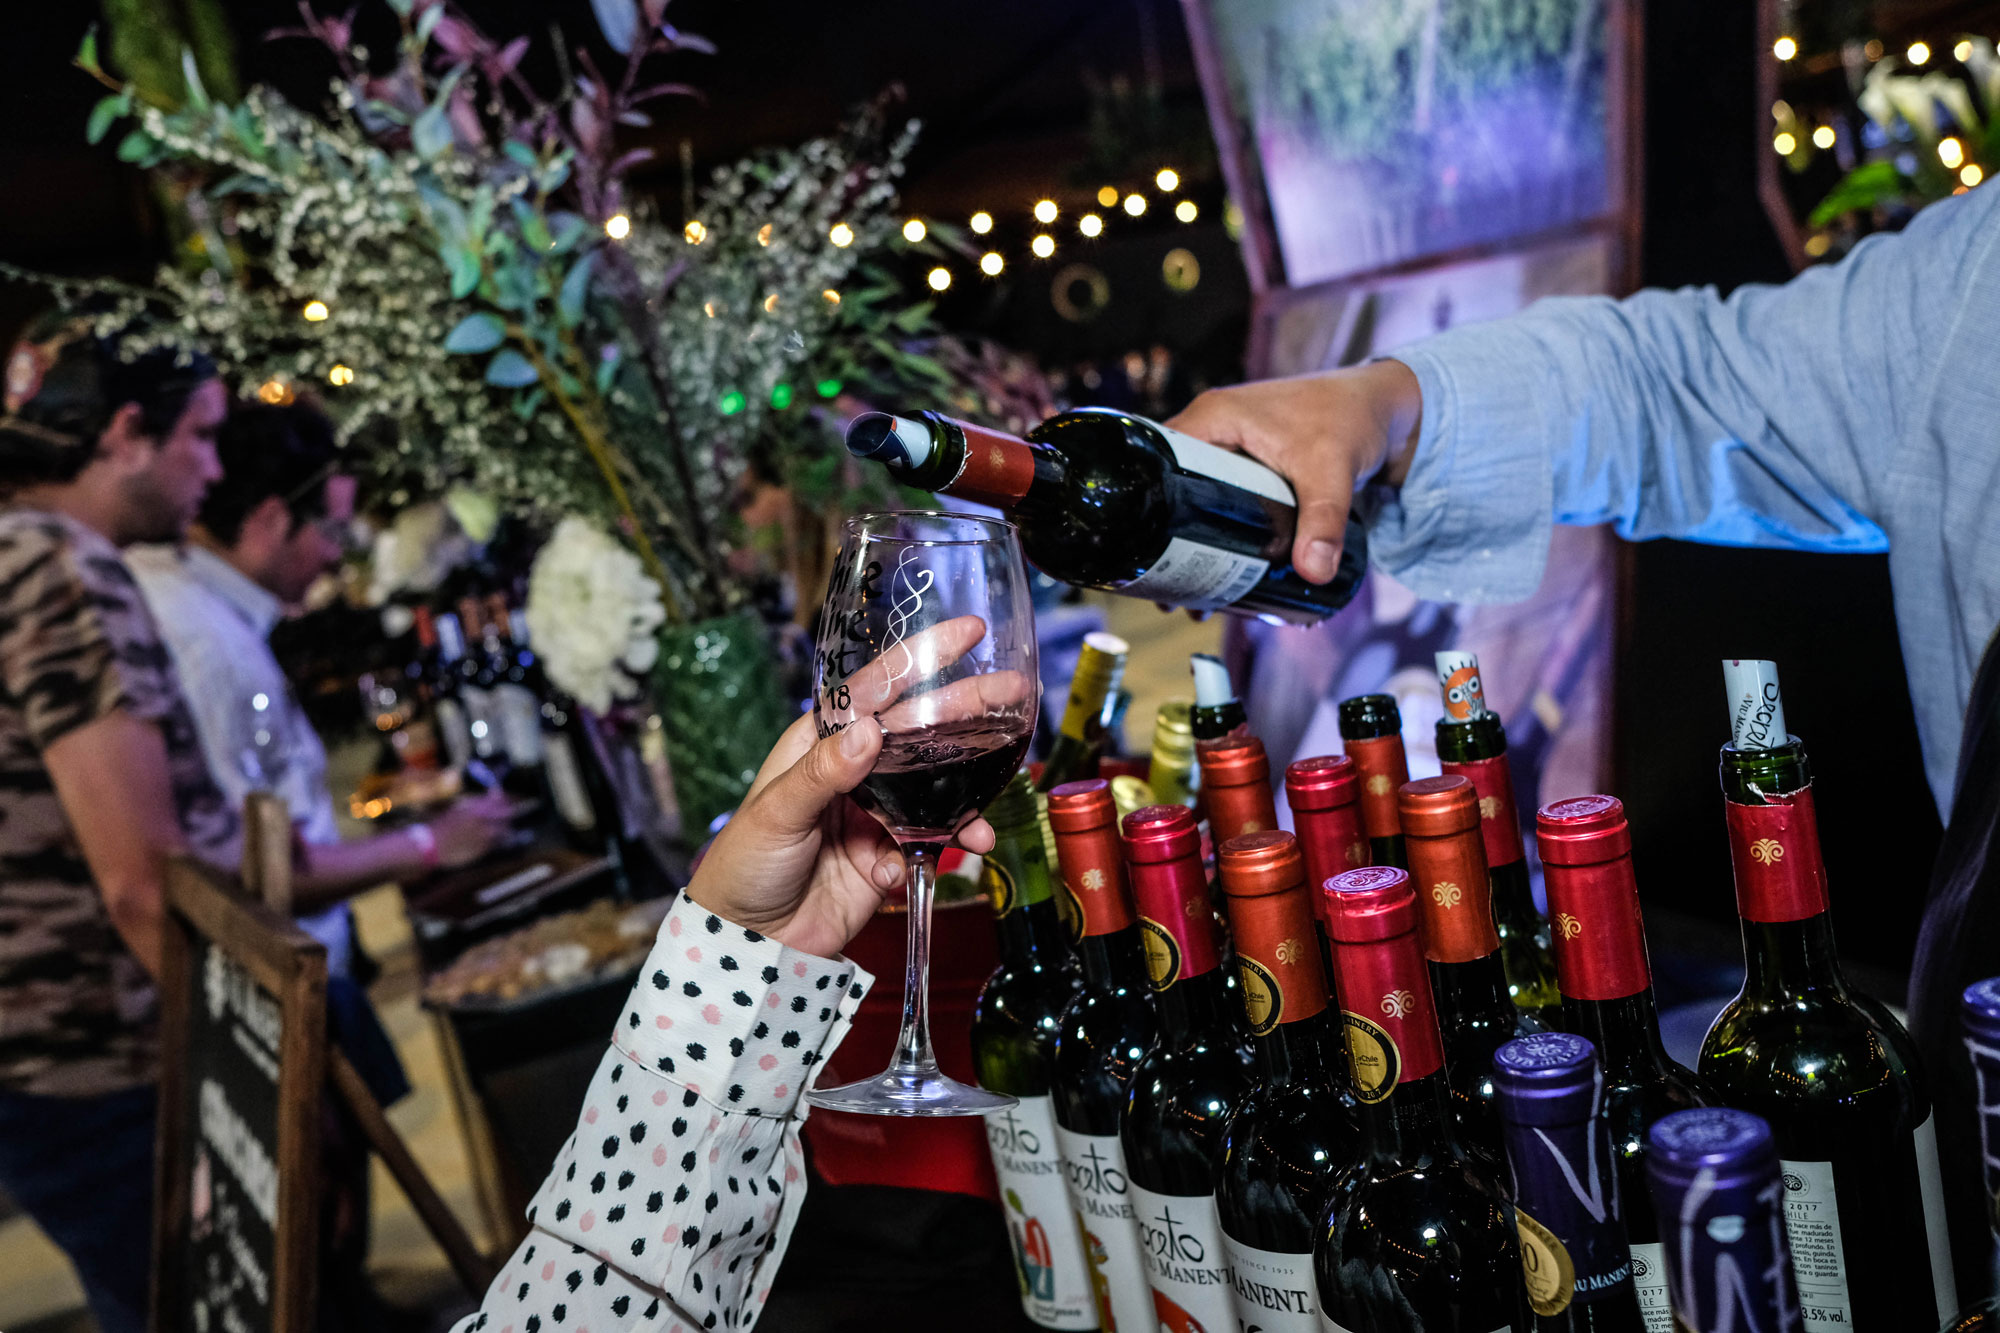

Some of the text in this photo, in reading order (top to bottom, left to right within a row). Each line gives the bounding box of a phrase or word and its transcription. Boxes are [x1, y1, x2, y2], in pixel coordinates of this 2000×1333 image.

[1743, 682, 1781, 750] Secret
[1349, 1017, 1379, 1036] INERY
[1086, 1196, 1137, 1219] MANE
[1789, 1203, 1817, 1211] 2017
[1801, 1229, 1833, 1237] madurado
[1823, 1223, 1833, 1231] de
[1157, 1258, 1231, 1286] MANENT
[1271, 1266, 1295, 1276] 1935
[1801, 1306, 1848, 1323] 3.5% vol.
